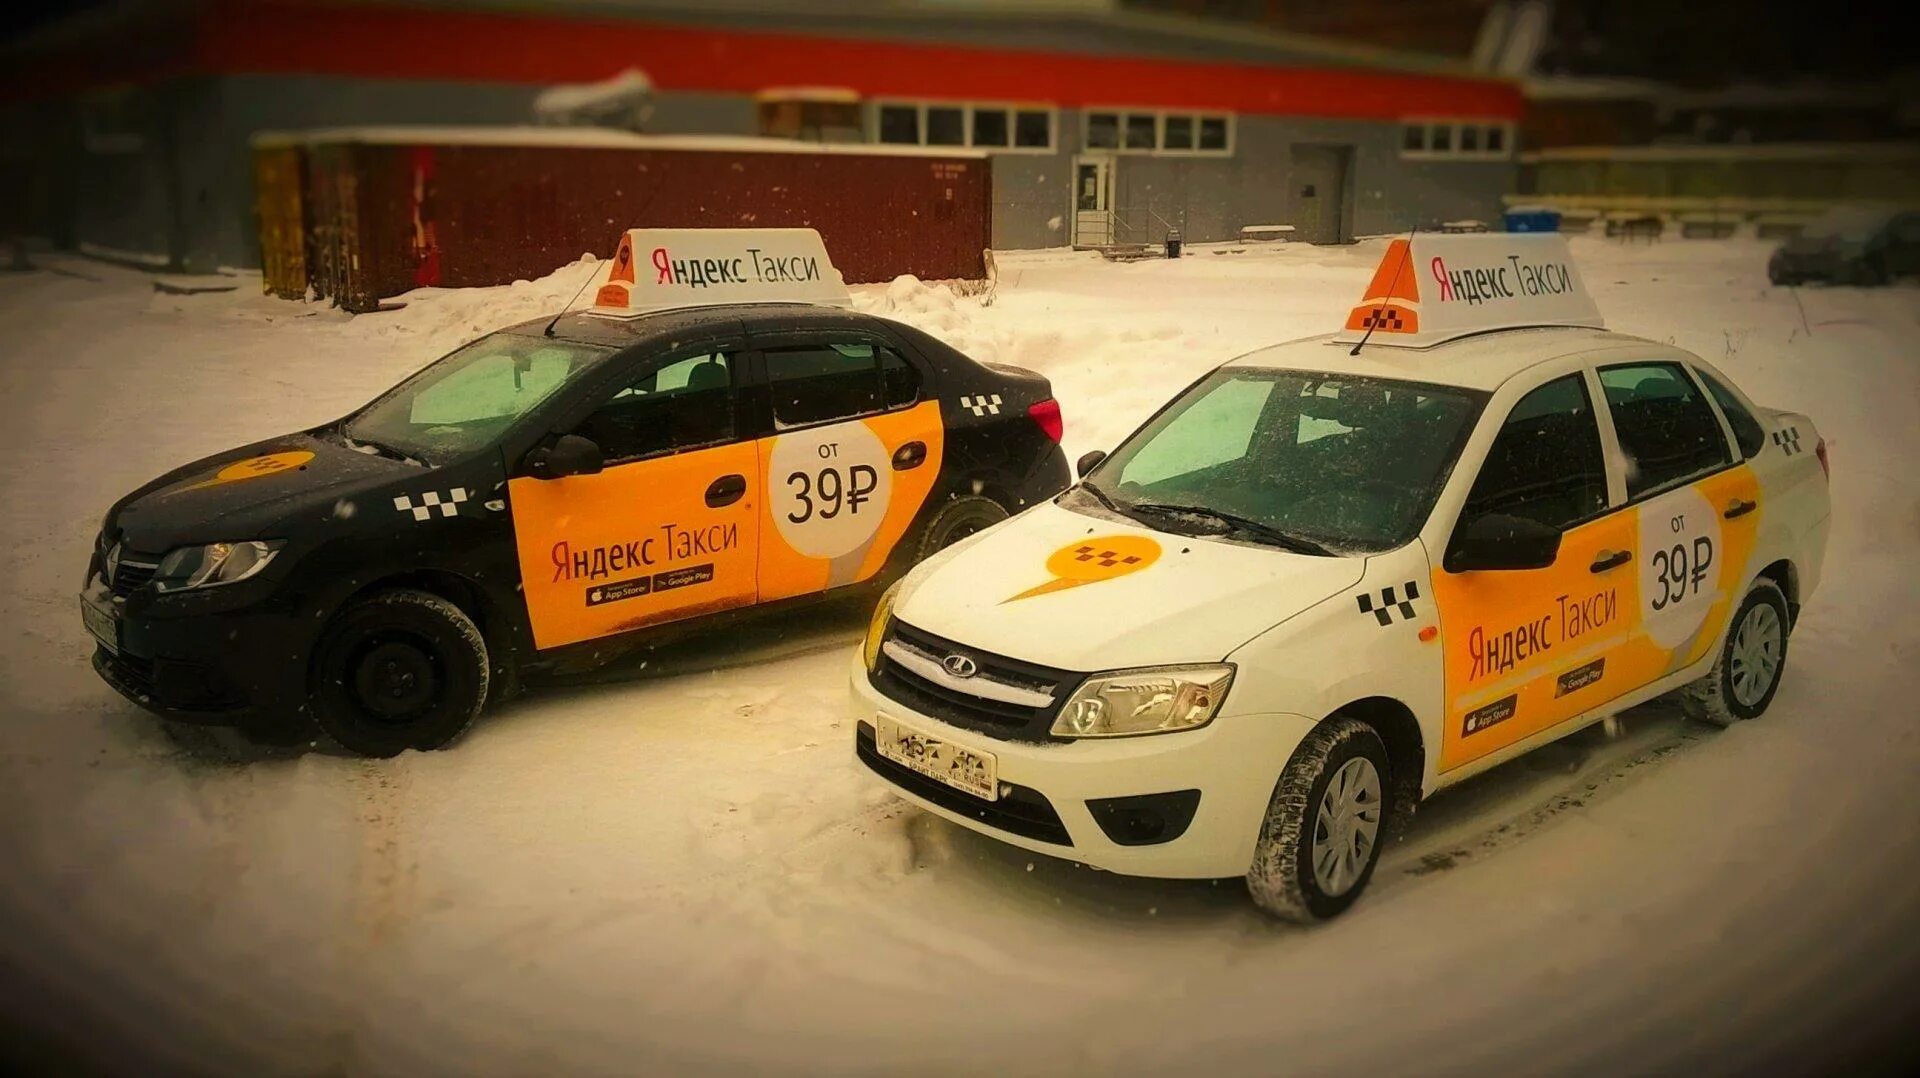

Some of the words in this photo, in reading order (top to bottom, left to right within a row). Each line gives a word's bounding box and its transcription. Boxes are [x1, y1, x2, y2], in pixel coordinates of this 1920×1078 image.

[651, 247, 747, 288] Яндекс
[746, 248, 821, 283] Такси
[1431, 256, 1514, 305] Яндекс
[1507, 255, 1574, 297] Такси
[552, 536, 654, 584] Яндекс
[660, 522, 738, 561] Такси
[605, 589, 623, 600] App
[668, 577, 695, 586] Google
[695, 572, 711, 581] Play
[1468, 615, 1553, 682] Яндекс
[1555, 587, 1617, 643] Такси
